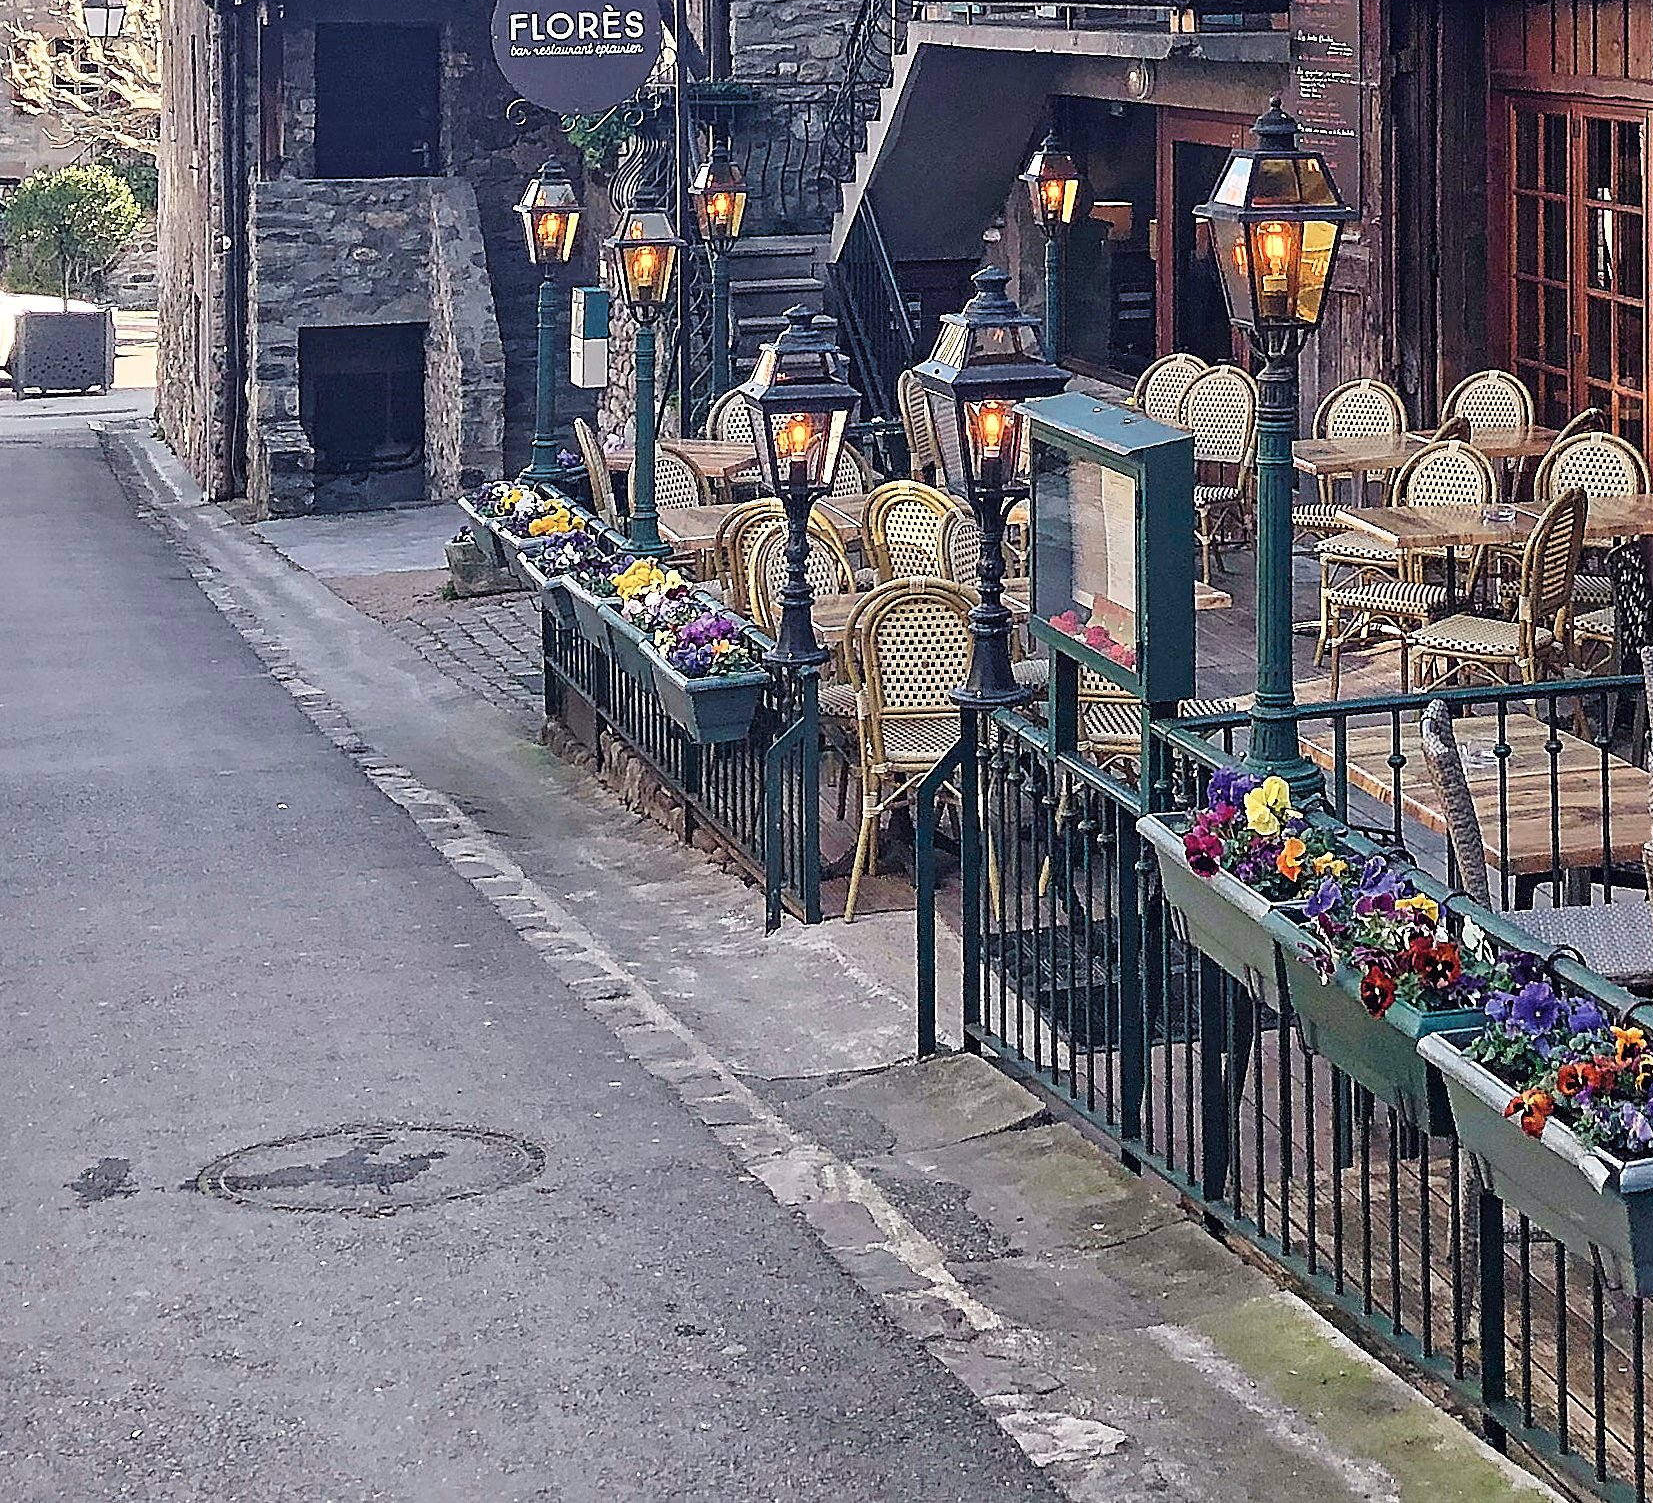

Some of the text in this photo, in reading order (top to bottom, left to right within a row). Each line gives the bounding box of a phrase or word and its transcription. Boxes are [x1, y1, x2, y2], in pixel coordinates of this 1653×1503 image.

[509, 4, 645, 42] FLORÈS
[510, 44, 532, 56] bar
[533, 43, 593, 56] restaurant
